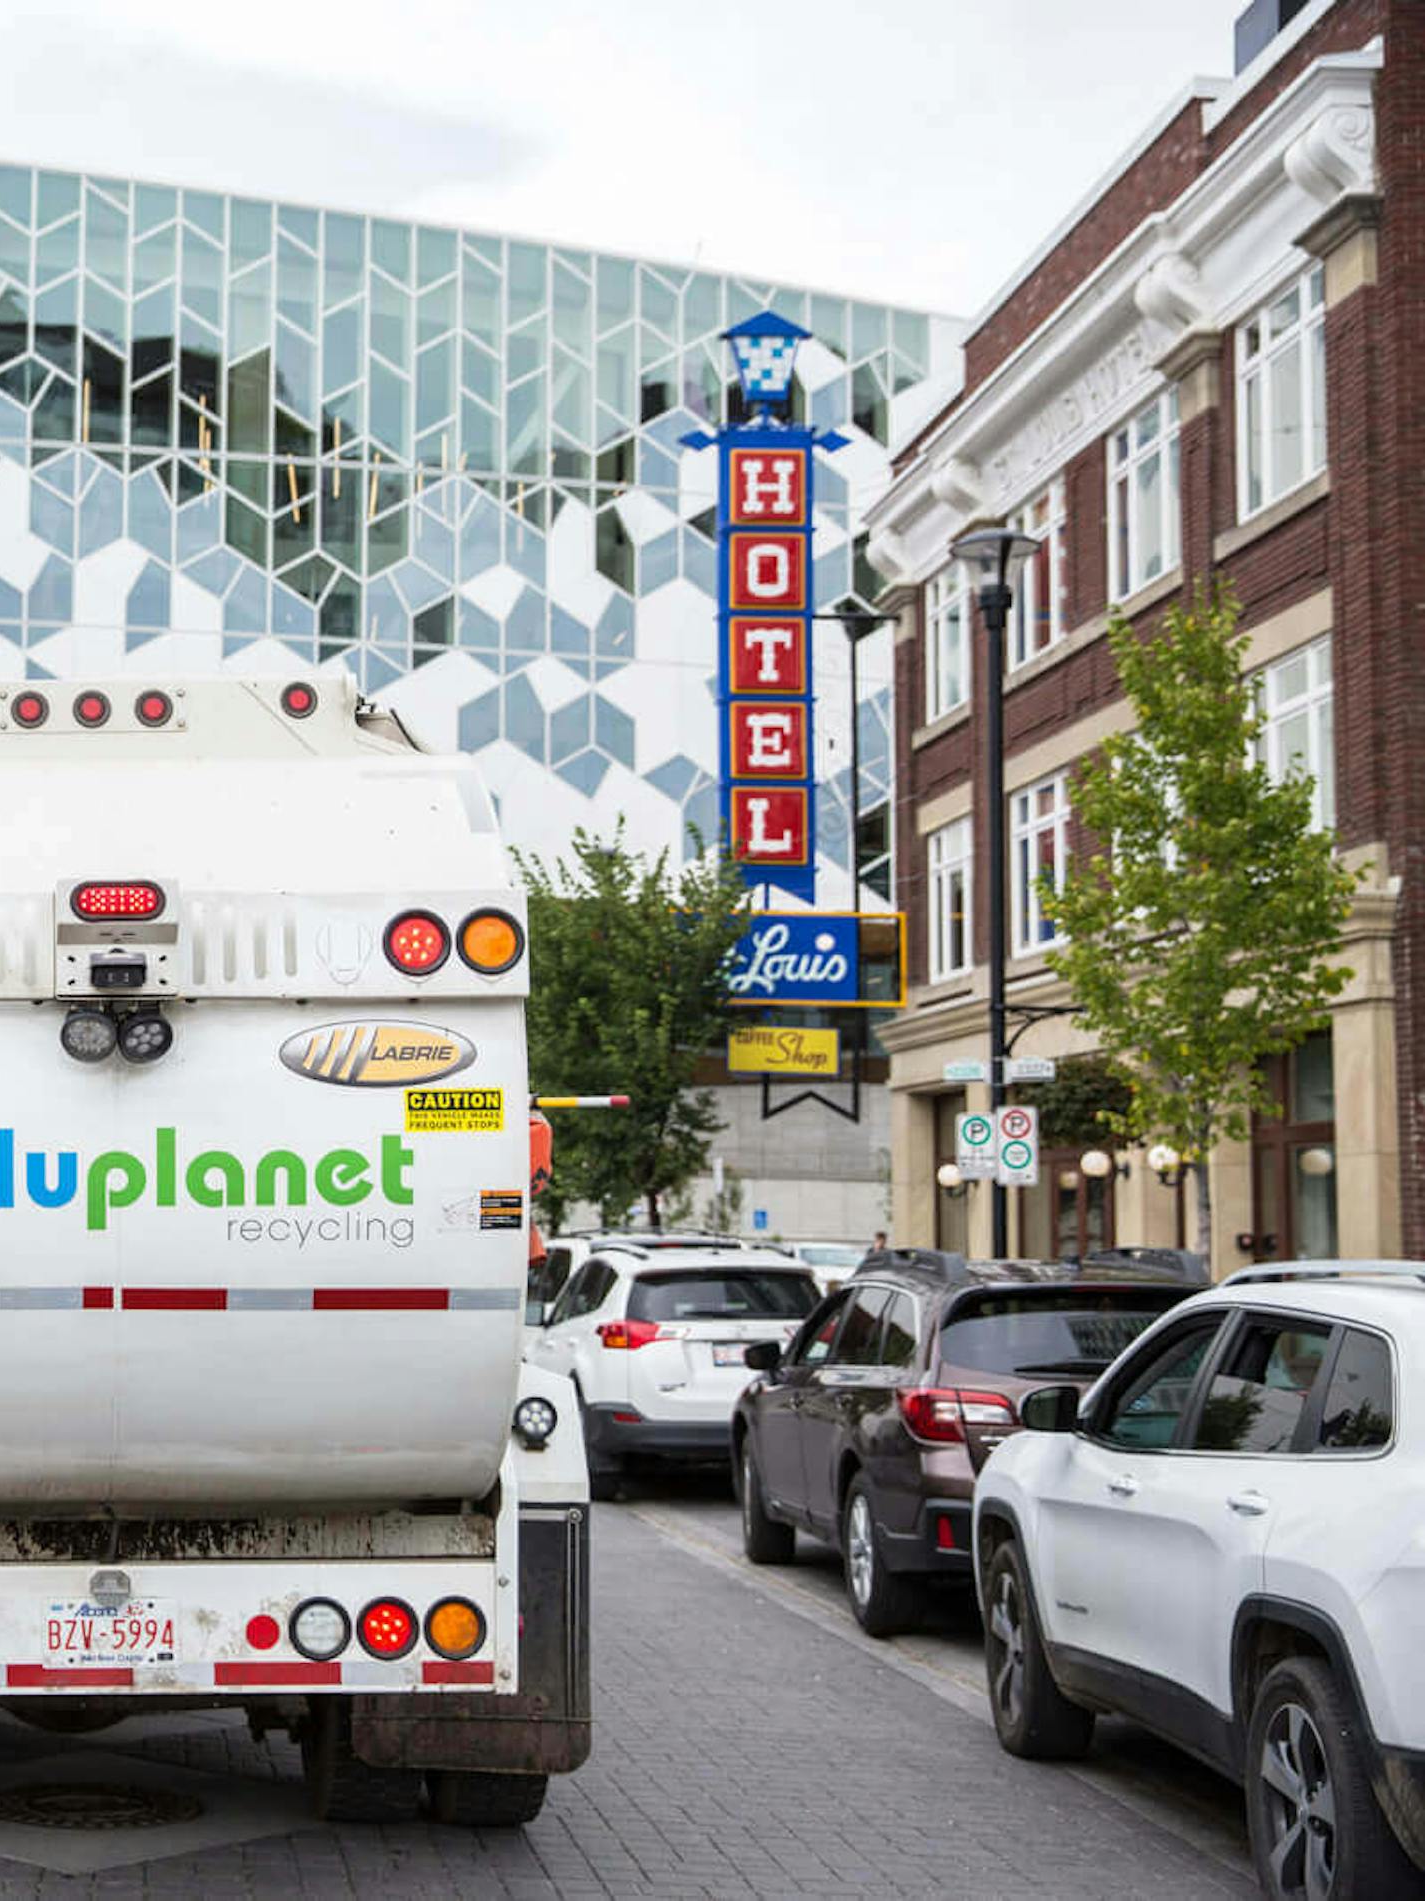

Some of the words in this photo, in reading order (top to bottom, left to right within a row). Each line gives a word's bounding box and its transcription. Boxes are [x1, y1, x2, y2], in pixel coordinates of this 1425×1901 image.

[741, 459, 795, 854] HOTEL
[728, 923, 847, 994] Louis
[371, 1045, 454, 1061] LABRIE
[765, 1032, 828, 1070] Shop
[409, 1092, 500, 1109] CAUTION
[467, 1120, 501, 1129] STOPS
[227, 1211, 414, 1248] recycling
[48, 1619, 174, 1650] BZV-5994
